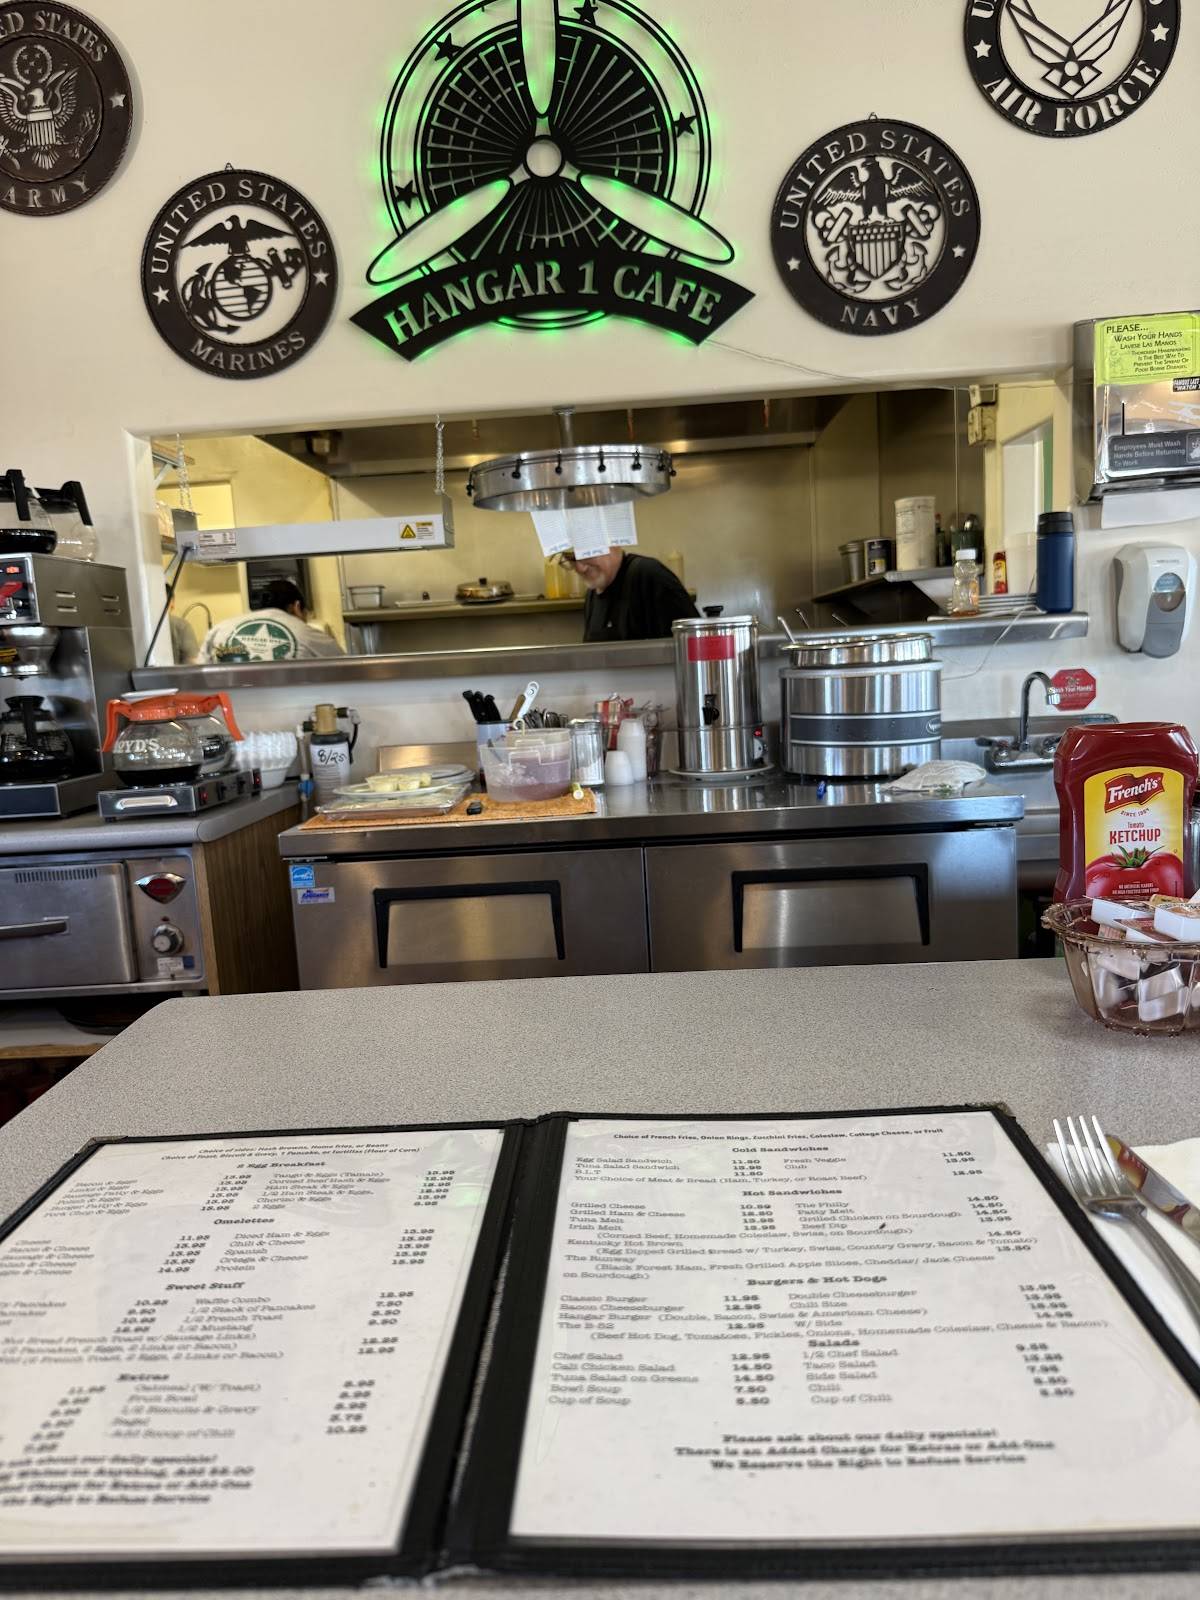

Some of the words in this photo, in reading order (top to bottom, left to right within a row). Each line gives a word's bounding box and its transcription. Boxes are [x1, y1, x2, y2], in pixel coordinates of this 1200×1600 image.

[34, 10, 107, 61] STATES
[984, 78, 1043, 126] AIR
[1055, 59, 1161, 132] FORCE
[780, 131, 866, 230] UNITED
[880, 129, 971, 217] STATES
[1, 173, 90, 208] ARMY
[150, 182, 226, 274] UNITED
[238, 179, 327, 258] STATES
[384, 260, 561, 345] HANGAR
[577, 261, 598, 295] 1
[613, 264, 722, 325] CAFE
[840, 299, 921, 327] NAVY
[190, 331, 306, 372] MARINES
[1113, 444, 1147, 452] Employees
[1155, 449, 1186, 457] Returning
[1107, 777, 1159, 804] French's
[1109, 828, 1161, 844] KETCHUP
[567, 1239, 621, 1247] Kentucky
[589, 1255, 636, 1263] Runway
[165, 1283, 206, 1291] Sweet
[599, 1304, 685, 1312] Cheeseburger
[558, 1313, 605, 1321] Hangar
[608, 1313, 652, 1321] Burger
[553, 1352, 585, 1360] Chef
[580, 1363, 635, 1371] Chicken
[638, 1364, 676, 1372] Salad
[550, 1384, 583, 1392] Bowl
[586, 1385, 622, 1393] Soup
